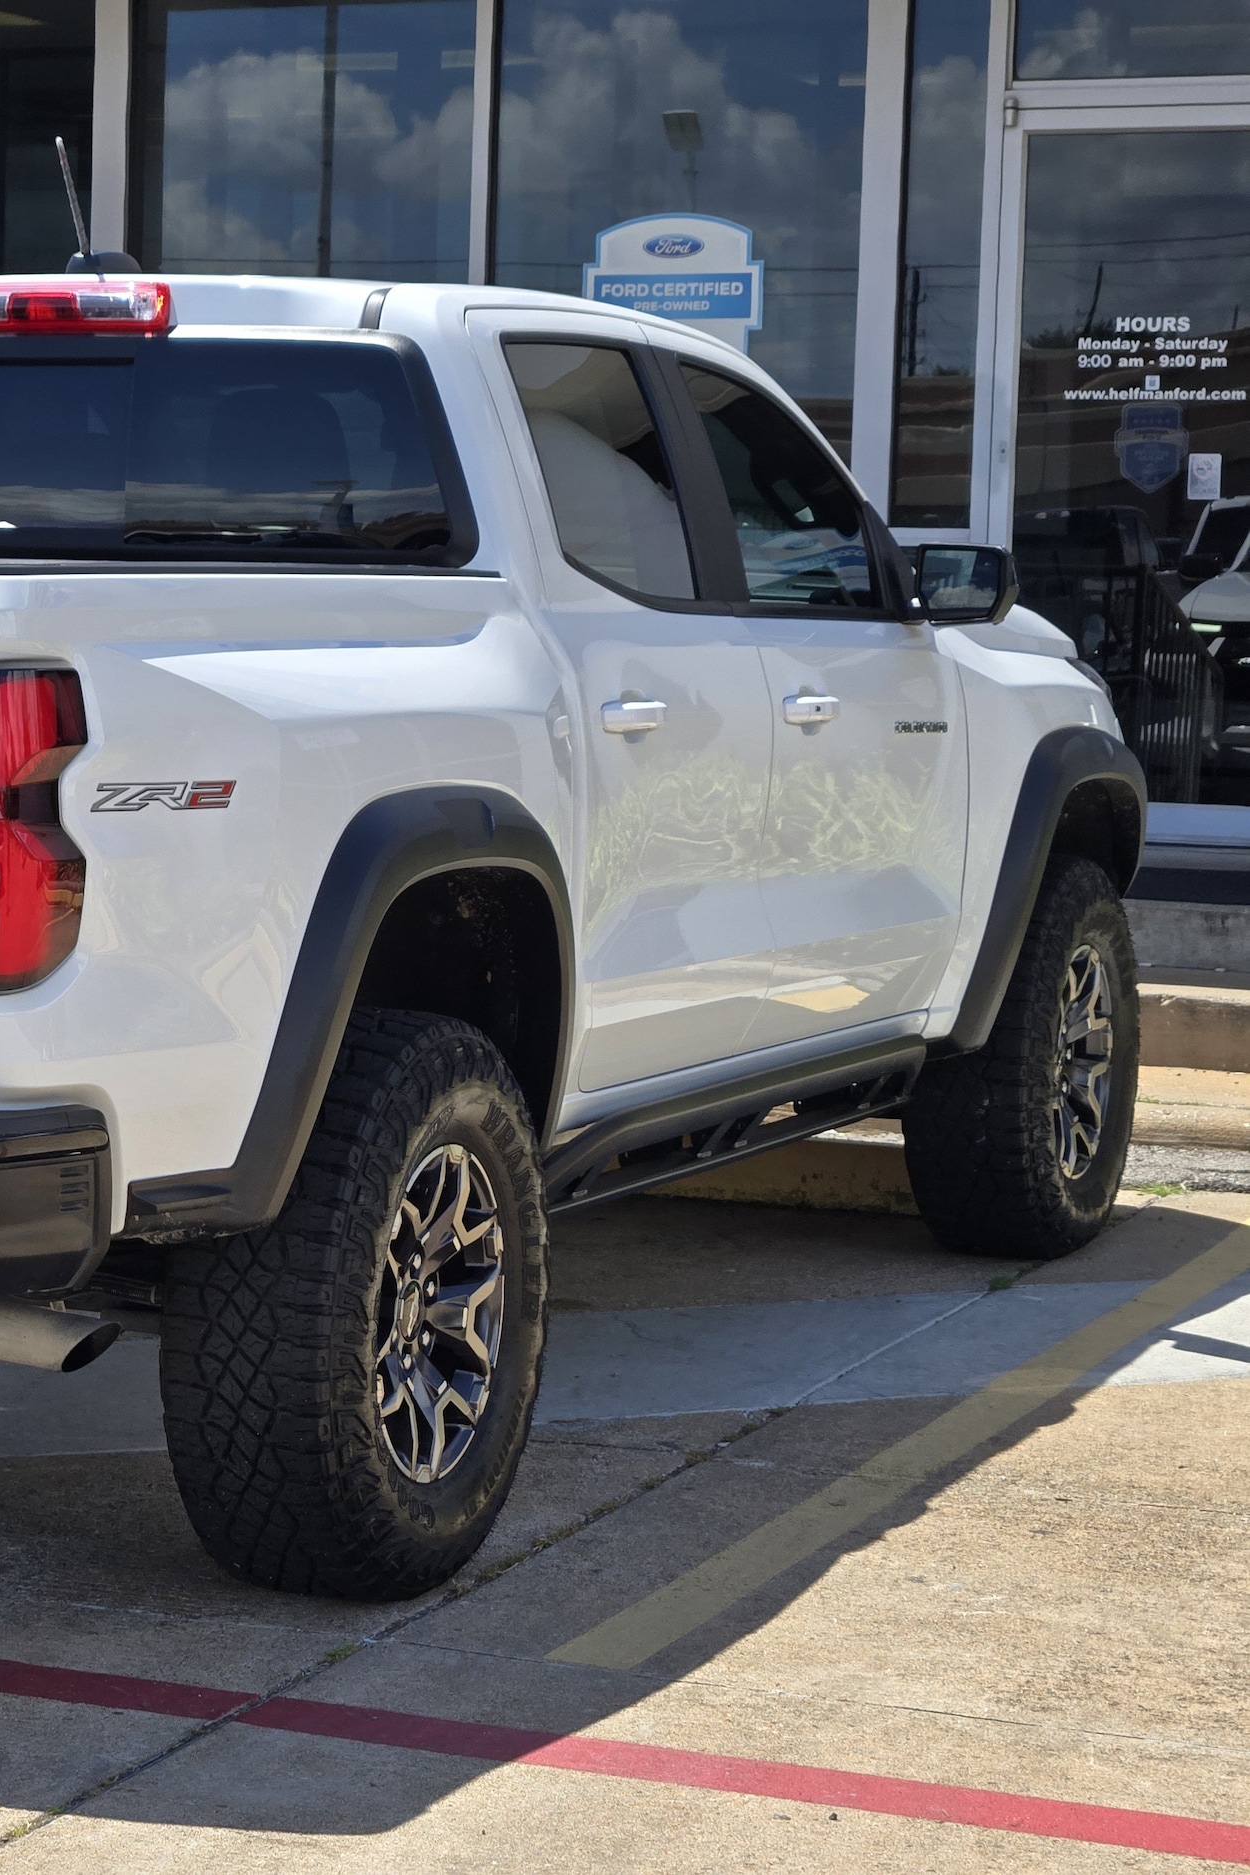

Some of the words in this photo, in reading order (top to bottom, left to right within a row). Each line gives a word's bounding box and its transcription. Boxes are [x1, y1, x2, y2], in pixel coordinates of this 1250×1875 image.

[654, 238, 692, 254] Ford
[601, 283, 649, 297] FORD
[652, 281, 744, 296] CERTIFIED
[633, 300, 710, 312] PRE-OWNED
[1115, 316, 1191, 332] HOURS
[1077, 337, 1141, 353] Monday
[1154, 337, 1228, 353] Saturday
[1077, 354, 1112, 368] 9:00
[1117, 356, 1144, 367] am
[1159, 354, 1196, 368] 9:00
[1200, 356, 1228, 370] pm
[1064, 387, 1247, 401] www.helfmanford.com
[90, 780, 237, 812] ZR2
[480, 1102, 541, 1322] WRANGLER
